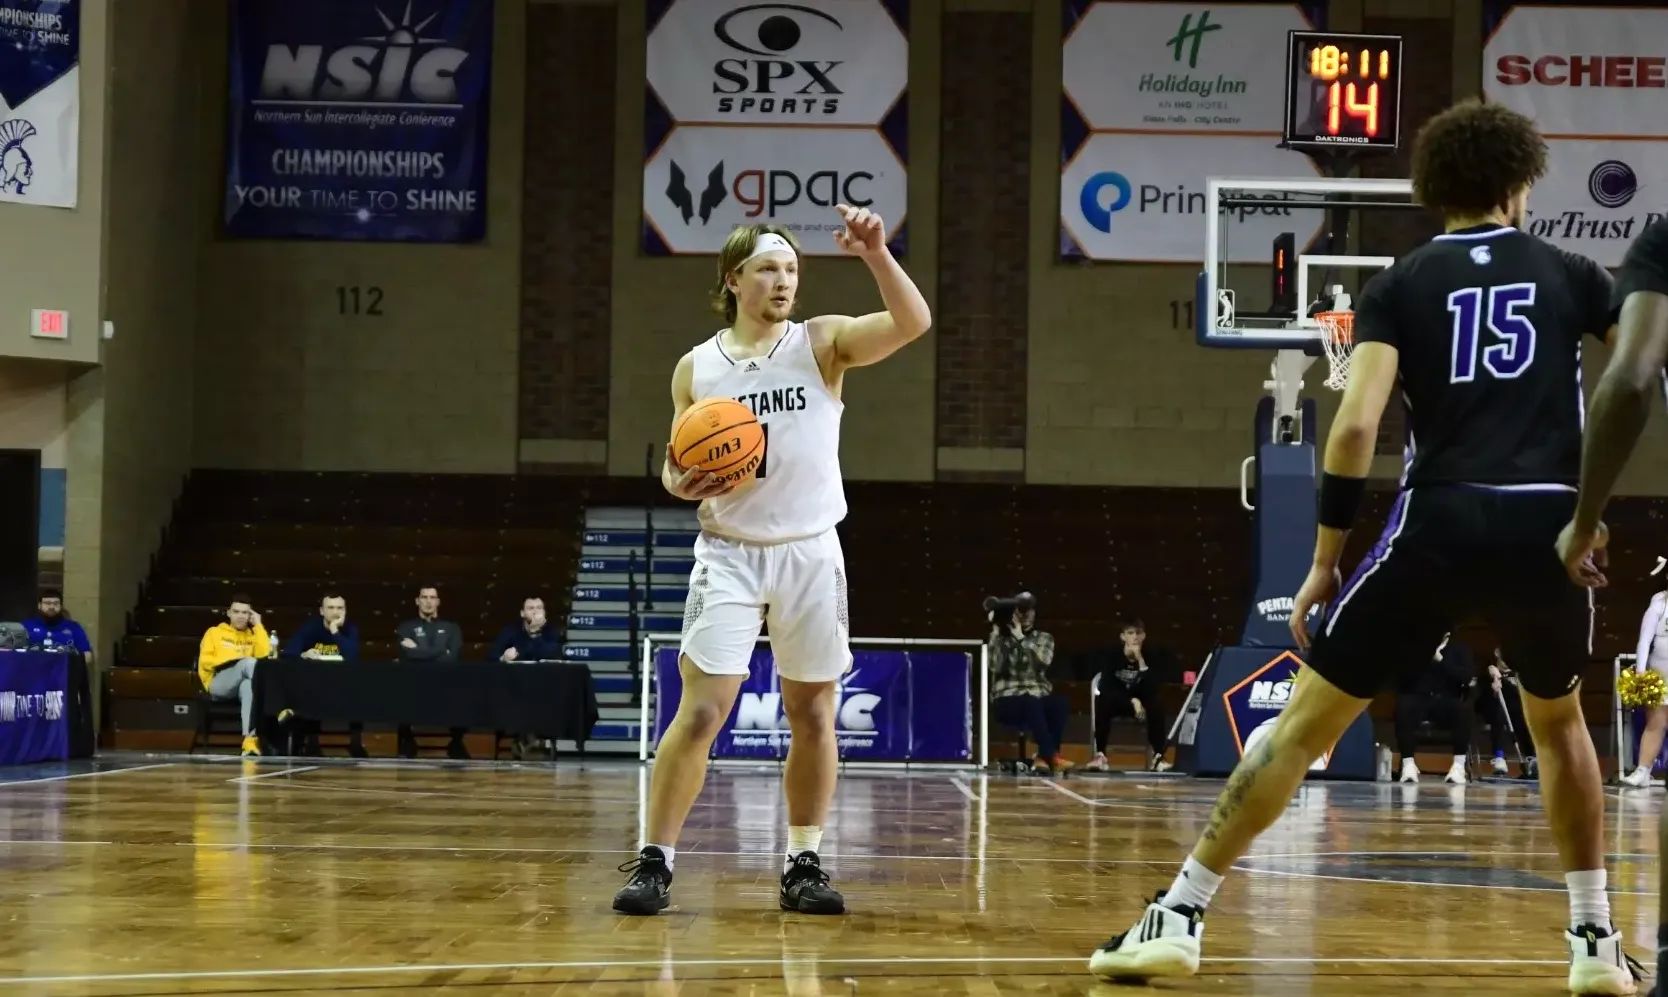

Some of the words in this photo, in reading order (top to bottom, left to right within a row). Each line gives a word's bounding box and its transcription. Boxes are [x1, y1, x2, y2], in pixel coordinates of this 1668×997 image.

[37, 30, 70, 46] SHINE
[259, 43, 469, 102] NSIC
[712, 58, 844, 94] SPX
[1310, 45, 1389, 80] 18:11
[1138, 72, 1214, 98] Holiday
[1215, 74, 1247, 94] Inn
[254, 109, 301, 123] Northern
[304, 109, 323, 124] Sun
[324, 109, 396, 129] Intercollegiate
[399, 111, 456, 127] Conference
[717, 97, 839, 114] SPORTS
[1328, 80, 1378, 136] 14
[1315, 135, 1369, 143] DAKTRONICS
[271, 148, 444, 178] CHAMPIONSHIPS
[234, 184, 301, 208] YOUR
[309, 188, 359, 209] TIME
[366, 190, 398, 210] TO
[406, 189, 476, 211] SHINE
[733, 169, 874, 218] gpac
[1139, 184, 1292, 223] Prinipal
[1526, 210, 1635, 239] orTrust
[336, 286, 384, 315] 112
[1446, 282, 1537, 384] 15
[731, 386, 806, 416] TANGS
[594, 534, 608, 542] 112
[590, 561, 604, 569] 112
[585, 589, 599, 598] 112
[579, 617, 594, 625] 112
[575, 648, 589, 656] 112
[735, 692, 882, 730] NC
